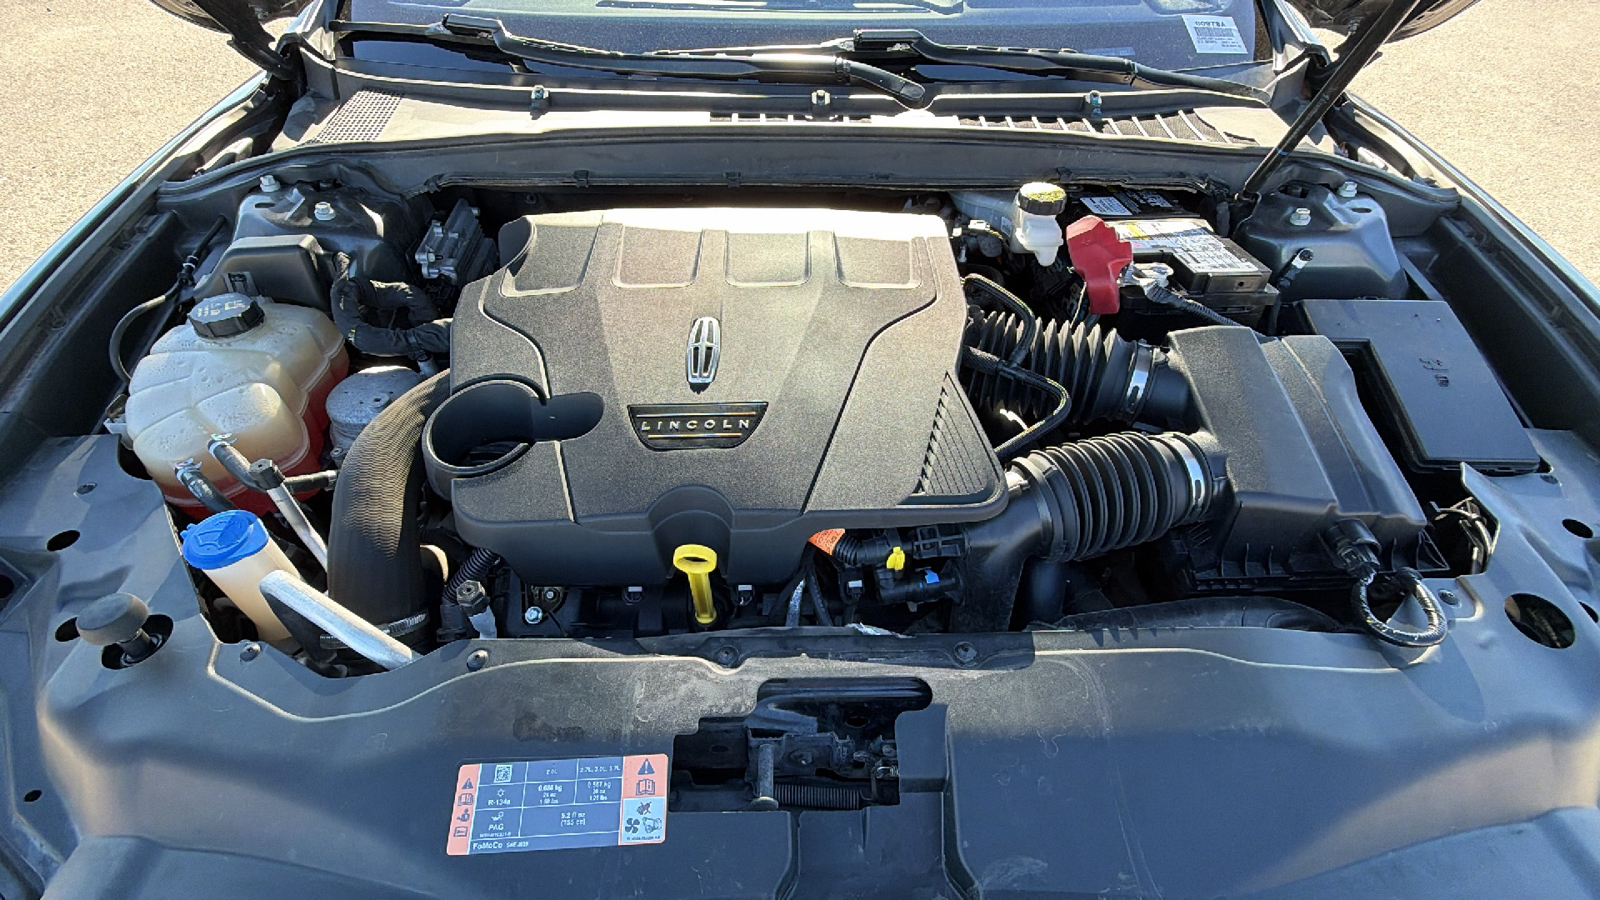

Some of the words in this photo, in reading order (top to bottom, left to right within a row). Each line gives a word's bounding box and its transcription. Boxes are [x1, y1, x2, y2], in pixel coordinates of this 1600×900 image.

[641, 419, 750, 431] LINCOLN
[554, 784, 563, 792] kg
[488, 798, 511, 806] R-134a
[488, 823, 504, 831] PAG
[473, 841, 503, 850] FoMoCo
